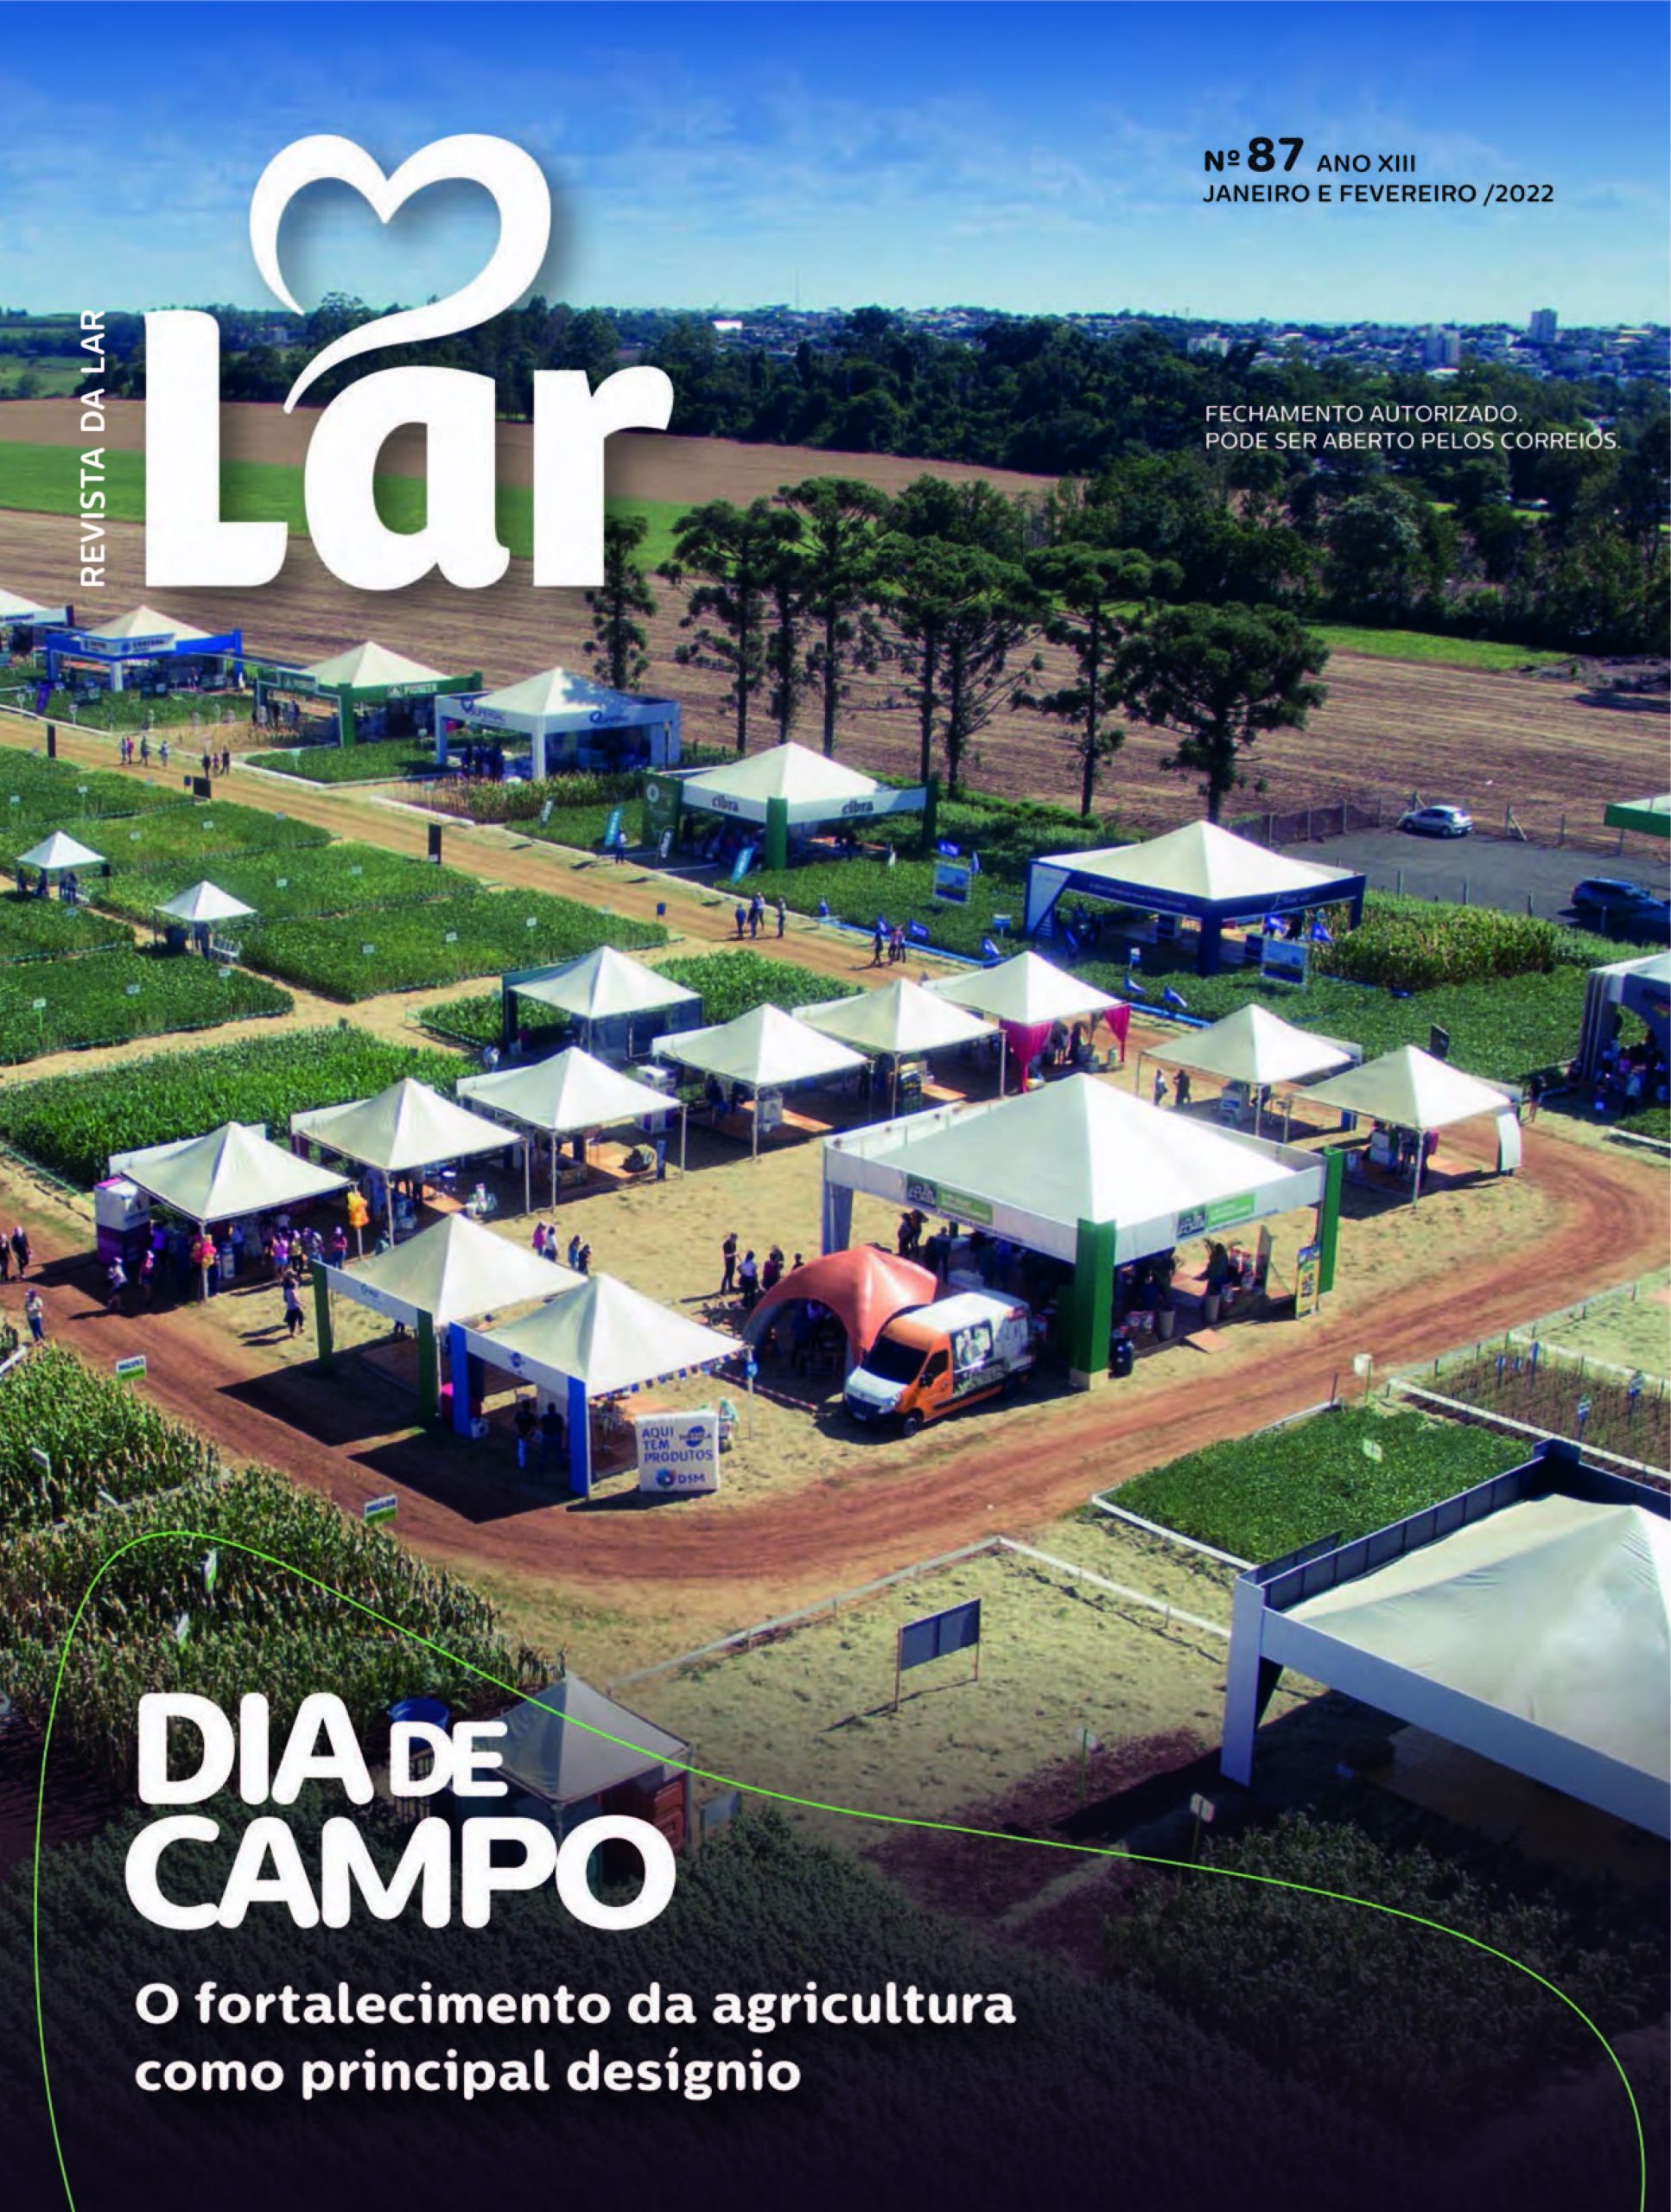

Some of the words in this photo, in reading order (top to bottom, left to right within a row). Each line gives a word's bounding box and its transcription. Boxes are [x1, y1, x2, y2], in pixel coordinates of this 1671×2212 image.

[712, 794, 739, 813] cibra
[842, 798, 874, 817] cibra
[642, 1425, 674, 1440] AQUI
[643, 1439, 670, 1451] TEM
[644, 1449, 714, 1464] PRODUTOS
